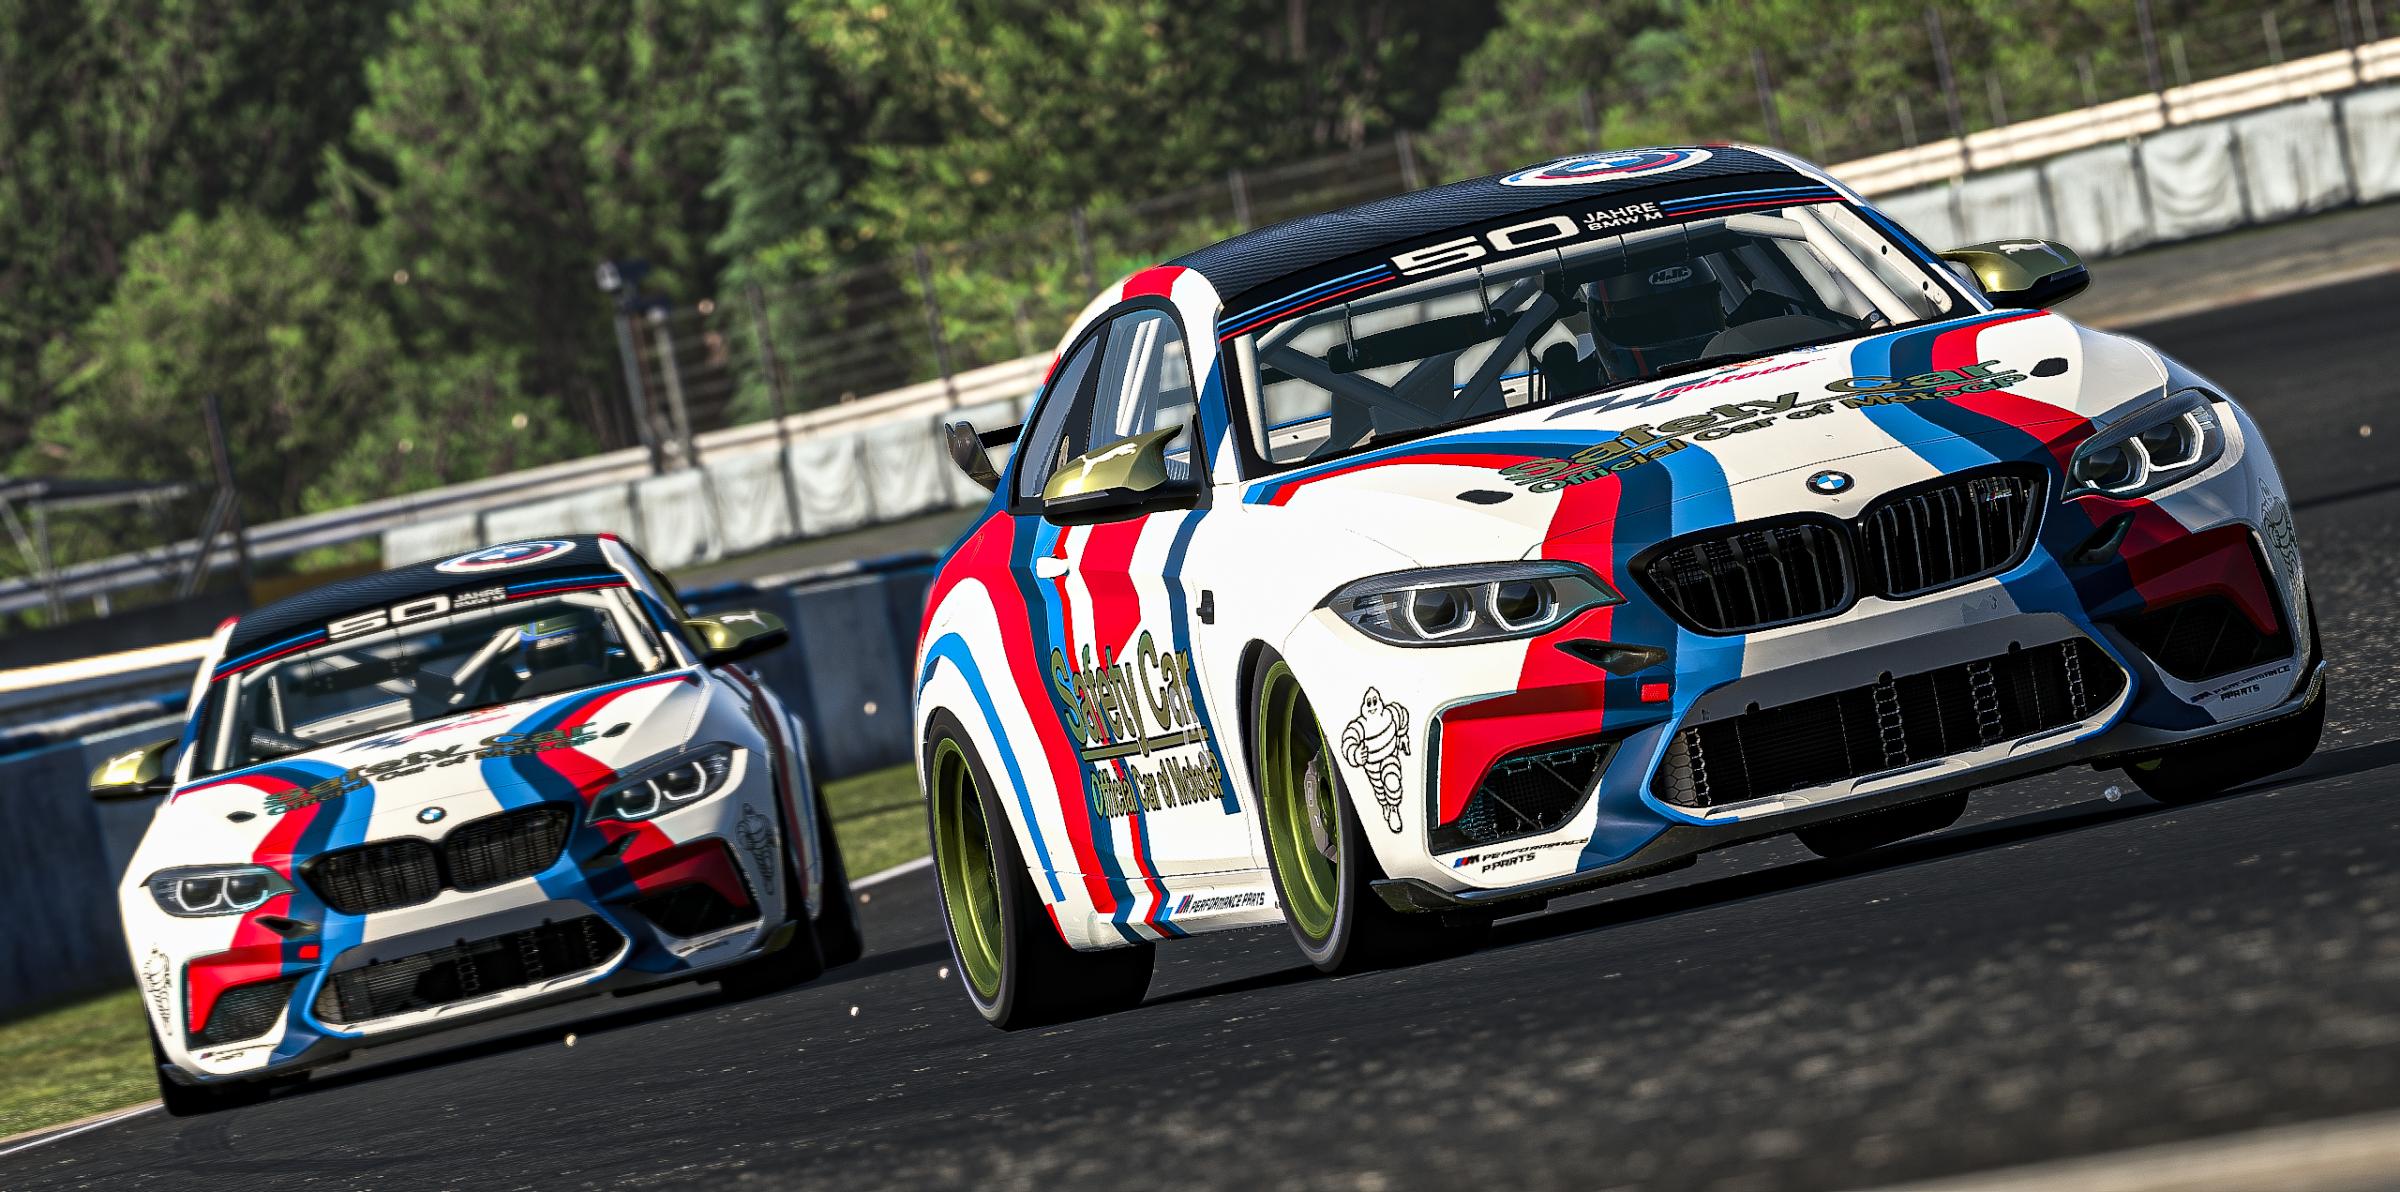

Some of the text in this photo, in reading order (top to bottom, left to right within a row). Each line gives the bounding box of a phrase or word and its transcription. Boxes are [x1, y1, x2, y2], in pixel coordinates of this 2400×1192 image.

[1583, 202, 1660, 223] JAHRE
[1587, 211, 1664, 231] BMW M
[1390, 215, 1581, 276] 50
[1498, 359, 2002, 482] Safety Car
[1527, 372, 2028, 493] Official Car of MotoGP
[327, 593, 450, 640] 50
[1051, 630, 1199, 758] Safety Car
[1090, 749, 1225, 819] Official Car of MotoGP
[1190, 894, 1243, 913] PERFORMANCE
[1242, 892, 1265, 907] PARTS
